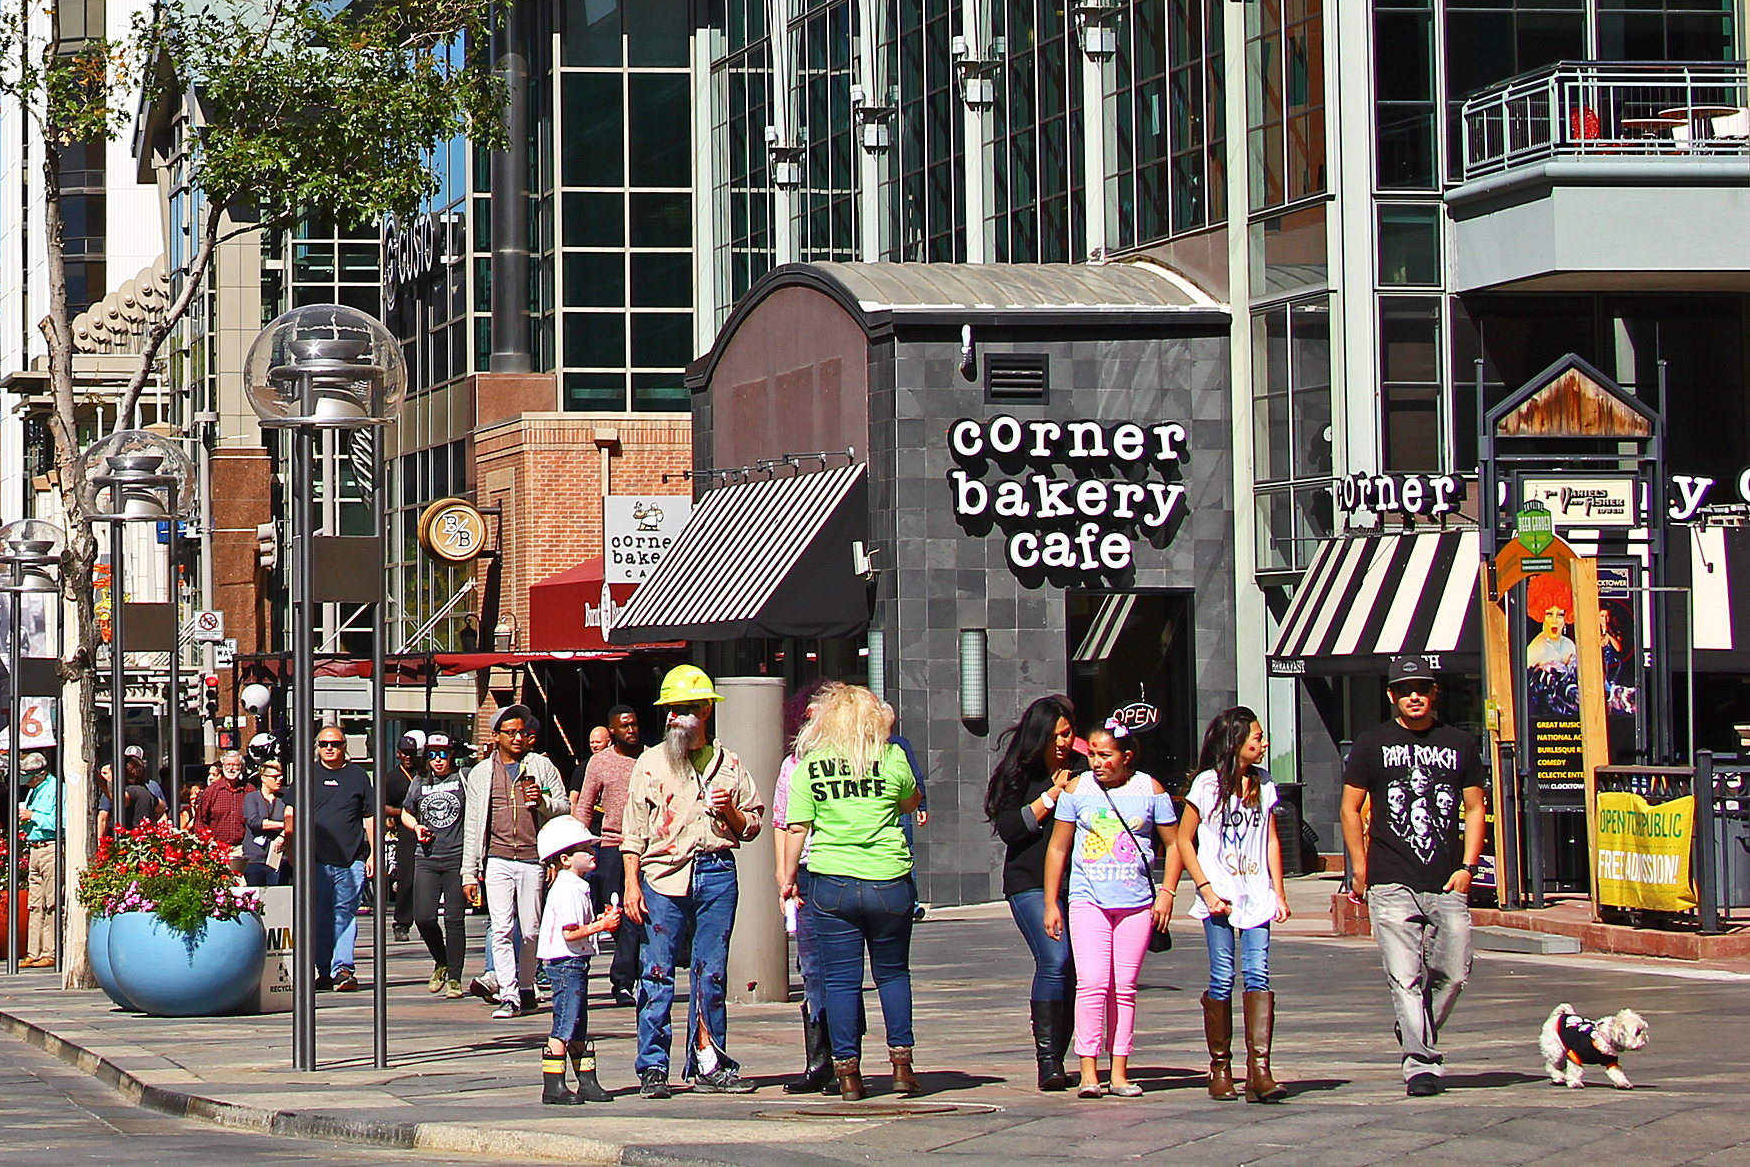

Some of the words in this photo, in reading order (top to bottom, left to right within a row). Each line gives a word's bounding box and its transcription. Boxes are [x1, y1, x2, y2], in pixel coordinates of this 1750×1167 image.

[952, 415, 1187, 461] corner
[952, 469, 1186, 527] bakery
[1335, 473, 1455, 515] corner
[611, 535, 672, 549] corne
[1009, 522, 1132, 571] cafe
[612, 550, 661, 565] bake
[625, 569, 647, 578] CA
[1113, 707, 1158, 724] OPEN
[1536, 721, 1558, 729] GREAT
[1559, 721, 1581, 729] MUSIC
[1382, 744, 1412, 769] PAPA
[1413, 743, 1457, 770] ROACH
[1537, 746, 1576, 754] BURLESQUE
[1537, 758, 1567, 766] COMEDY
[1538, 771, 1567, 779] ECLECTIC
[1568, 771, 1584, 779] ENTE
[810, 779, 887, 802] STAFF
[1222, 810, 1260, 827] LOVE
[1600, 809, 1626, 834] OPEN
[1081, 862, 1139, 882] BESTIES
[1598, 849, 1626, 881] FREE
[269, 985, 293, 993] RECYCL
